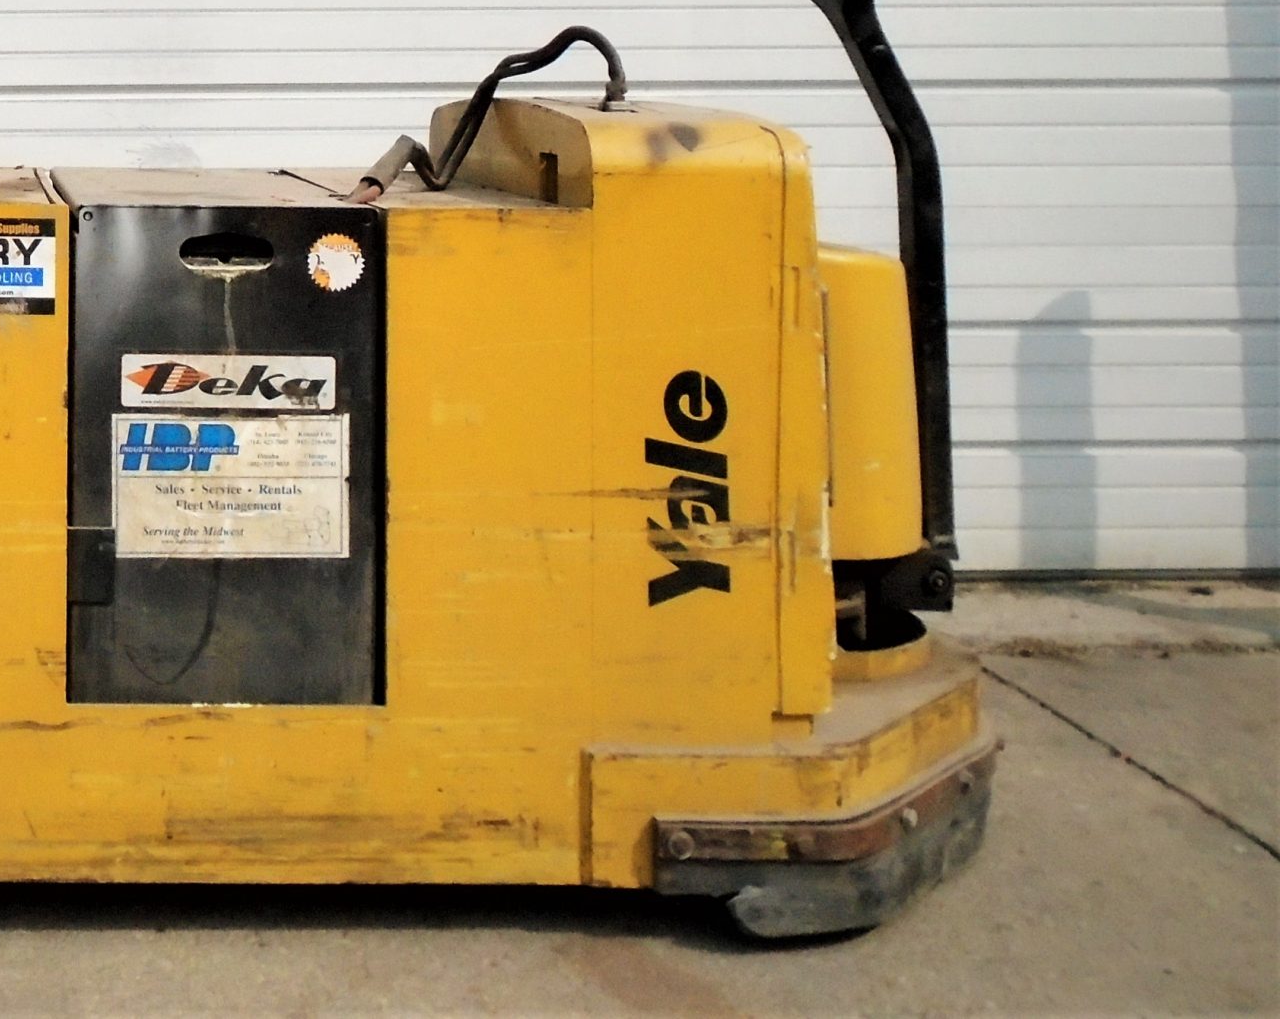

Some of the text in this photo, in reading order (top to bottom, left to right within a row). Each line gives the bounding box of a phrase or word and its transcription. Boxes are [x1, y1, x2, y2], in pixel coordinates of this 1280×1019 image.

[141, 362, 328, 400] Deka
[121, 423, 236, 471] IBP
[121, 445, 239, 455] INDUSTRIAL BATTERY PRODUCTS
[155, 484, 302, 495] Sales Service Rentals
[645, 369, 731, 608] Yale
[176, 499, 282, 513] Fleet Management
[143, 526, 245, 538] Serving the Midwest
